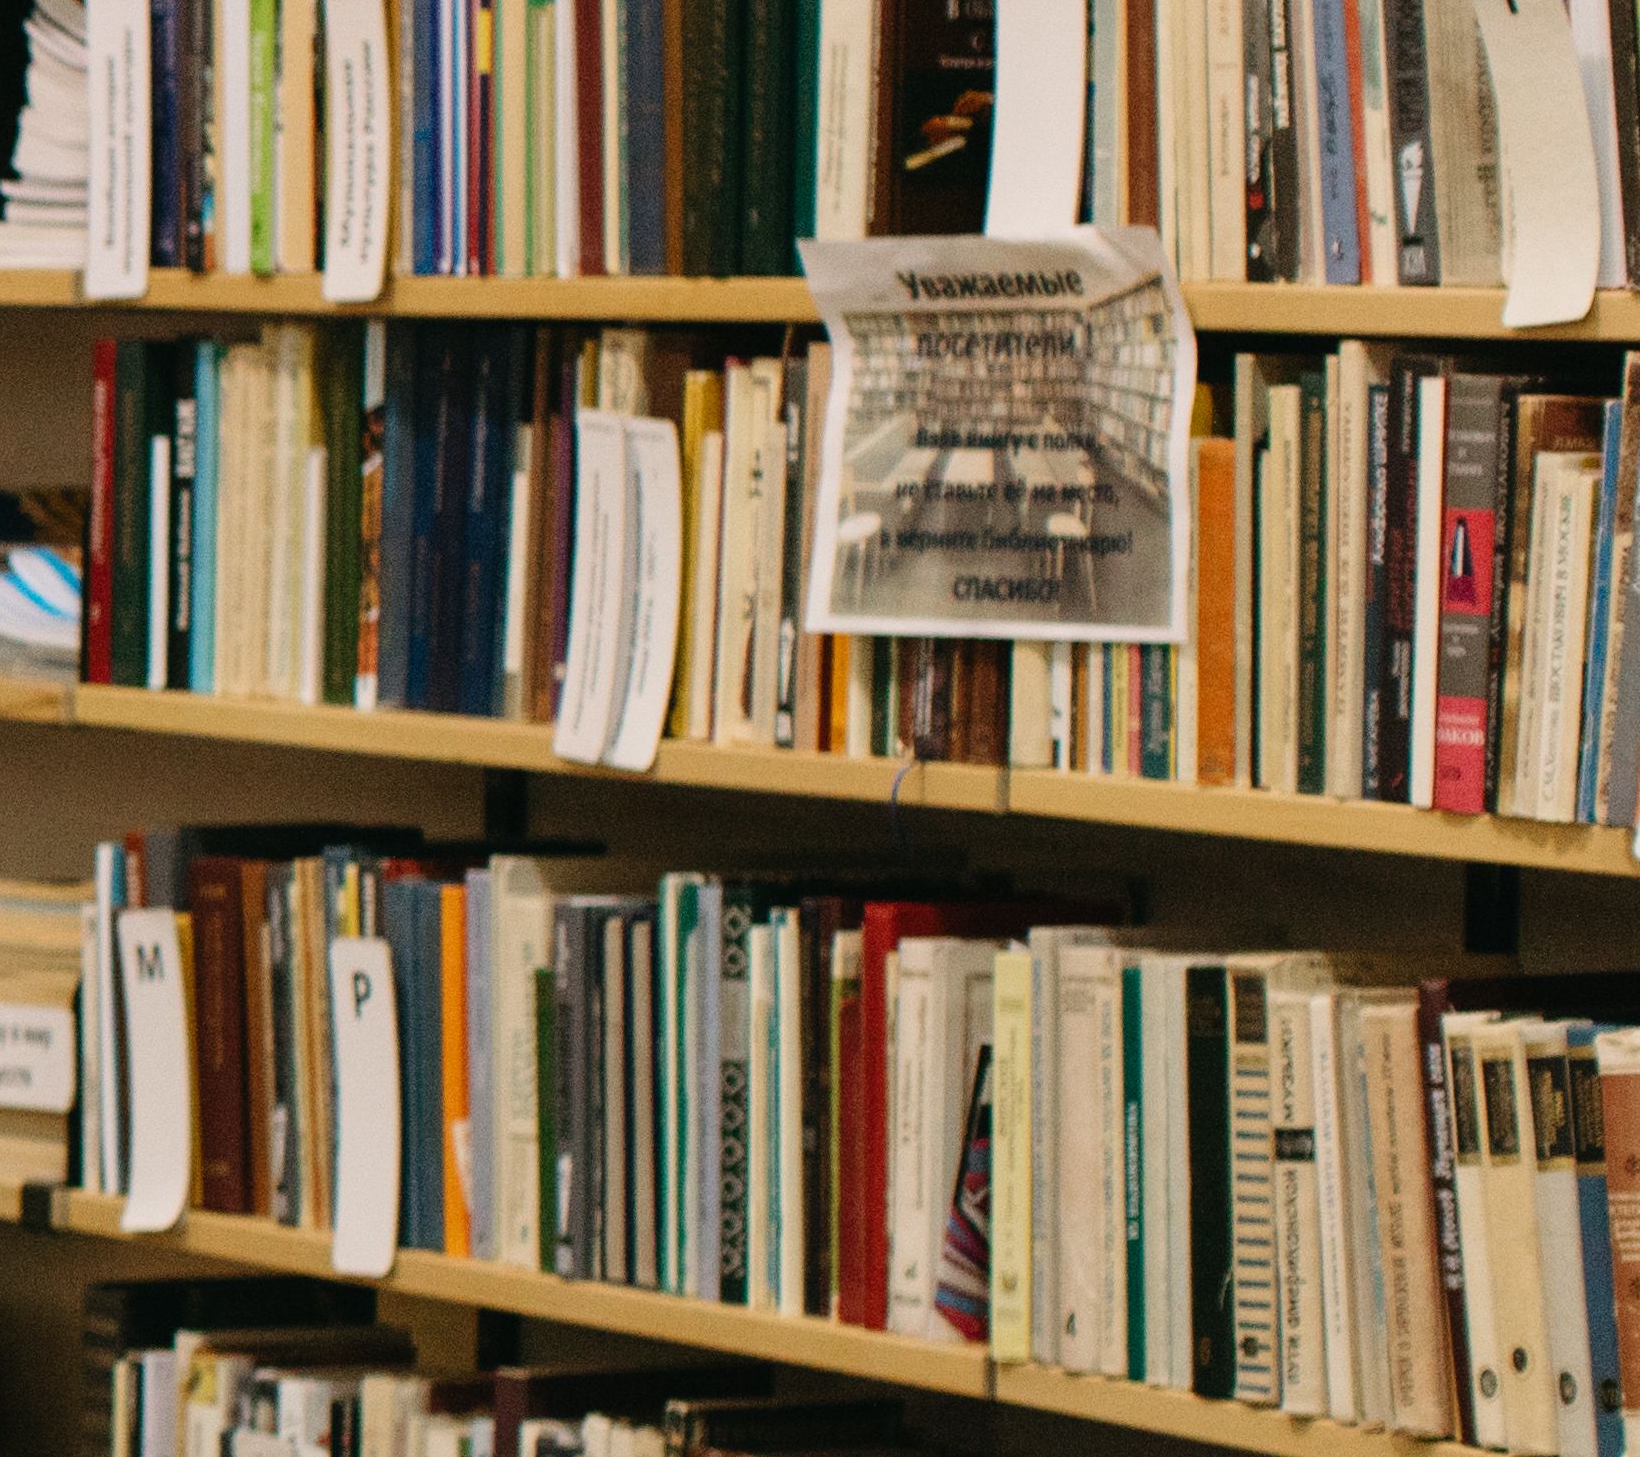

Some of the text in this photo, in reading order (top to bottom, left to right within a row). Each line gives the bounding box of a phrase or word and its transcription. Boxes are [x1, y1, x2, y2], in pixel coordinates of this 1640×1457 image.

[897, 269, 1084, 301] Уважаемые
[136, 942, 165, 983] М
[351, 972, 373, 1020] Р
[1283, 1169, 1307, 1330] американской
